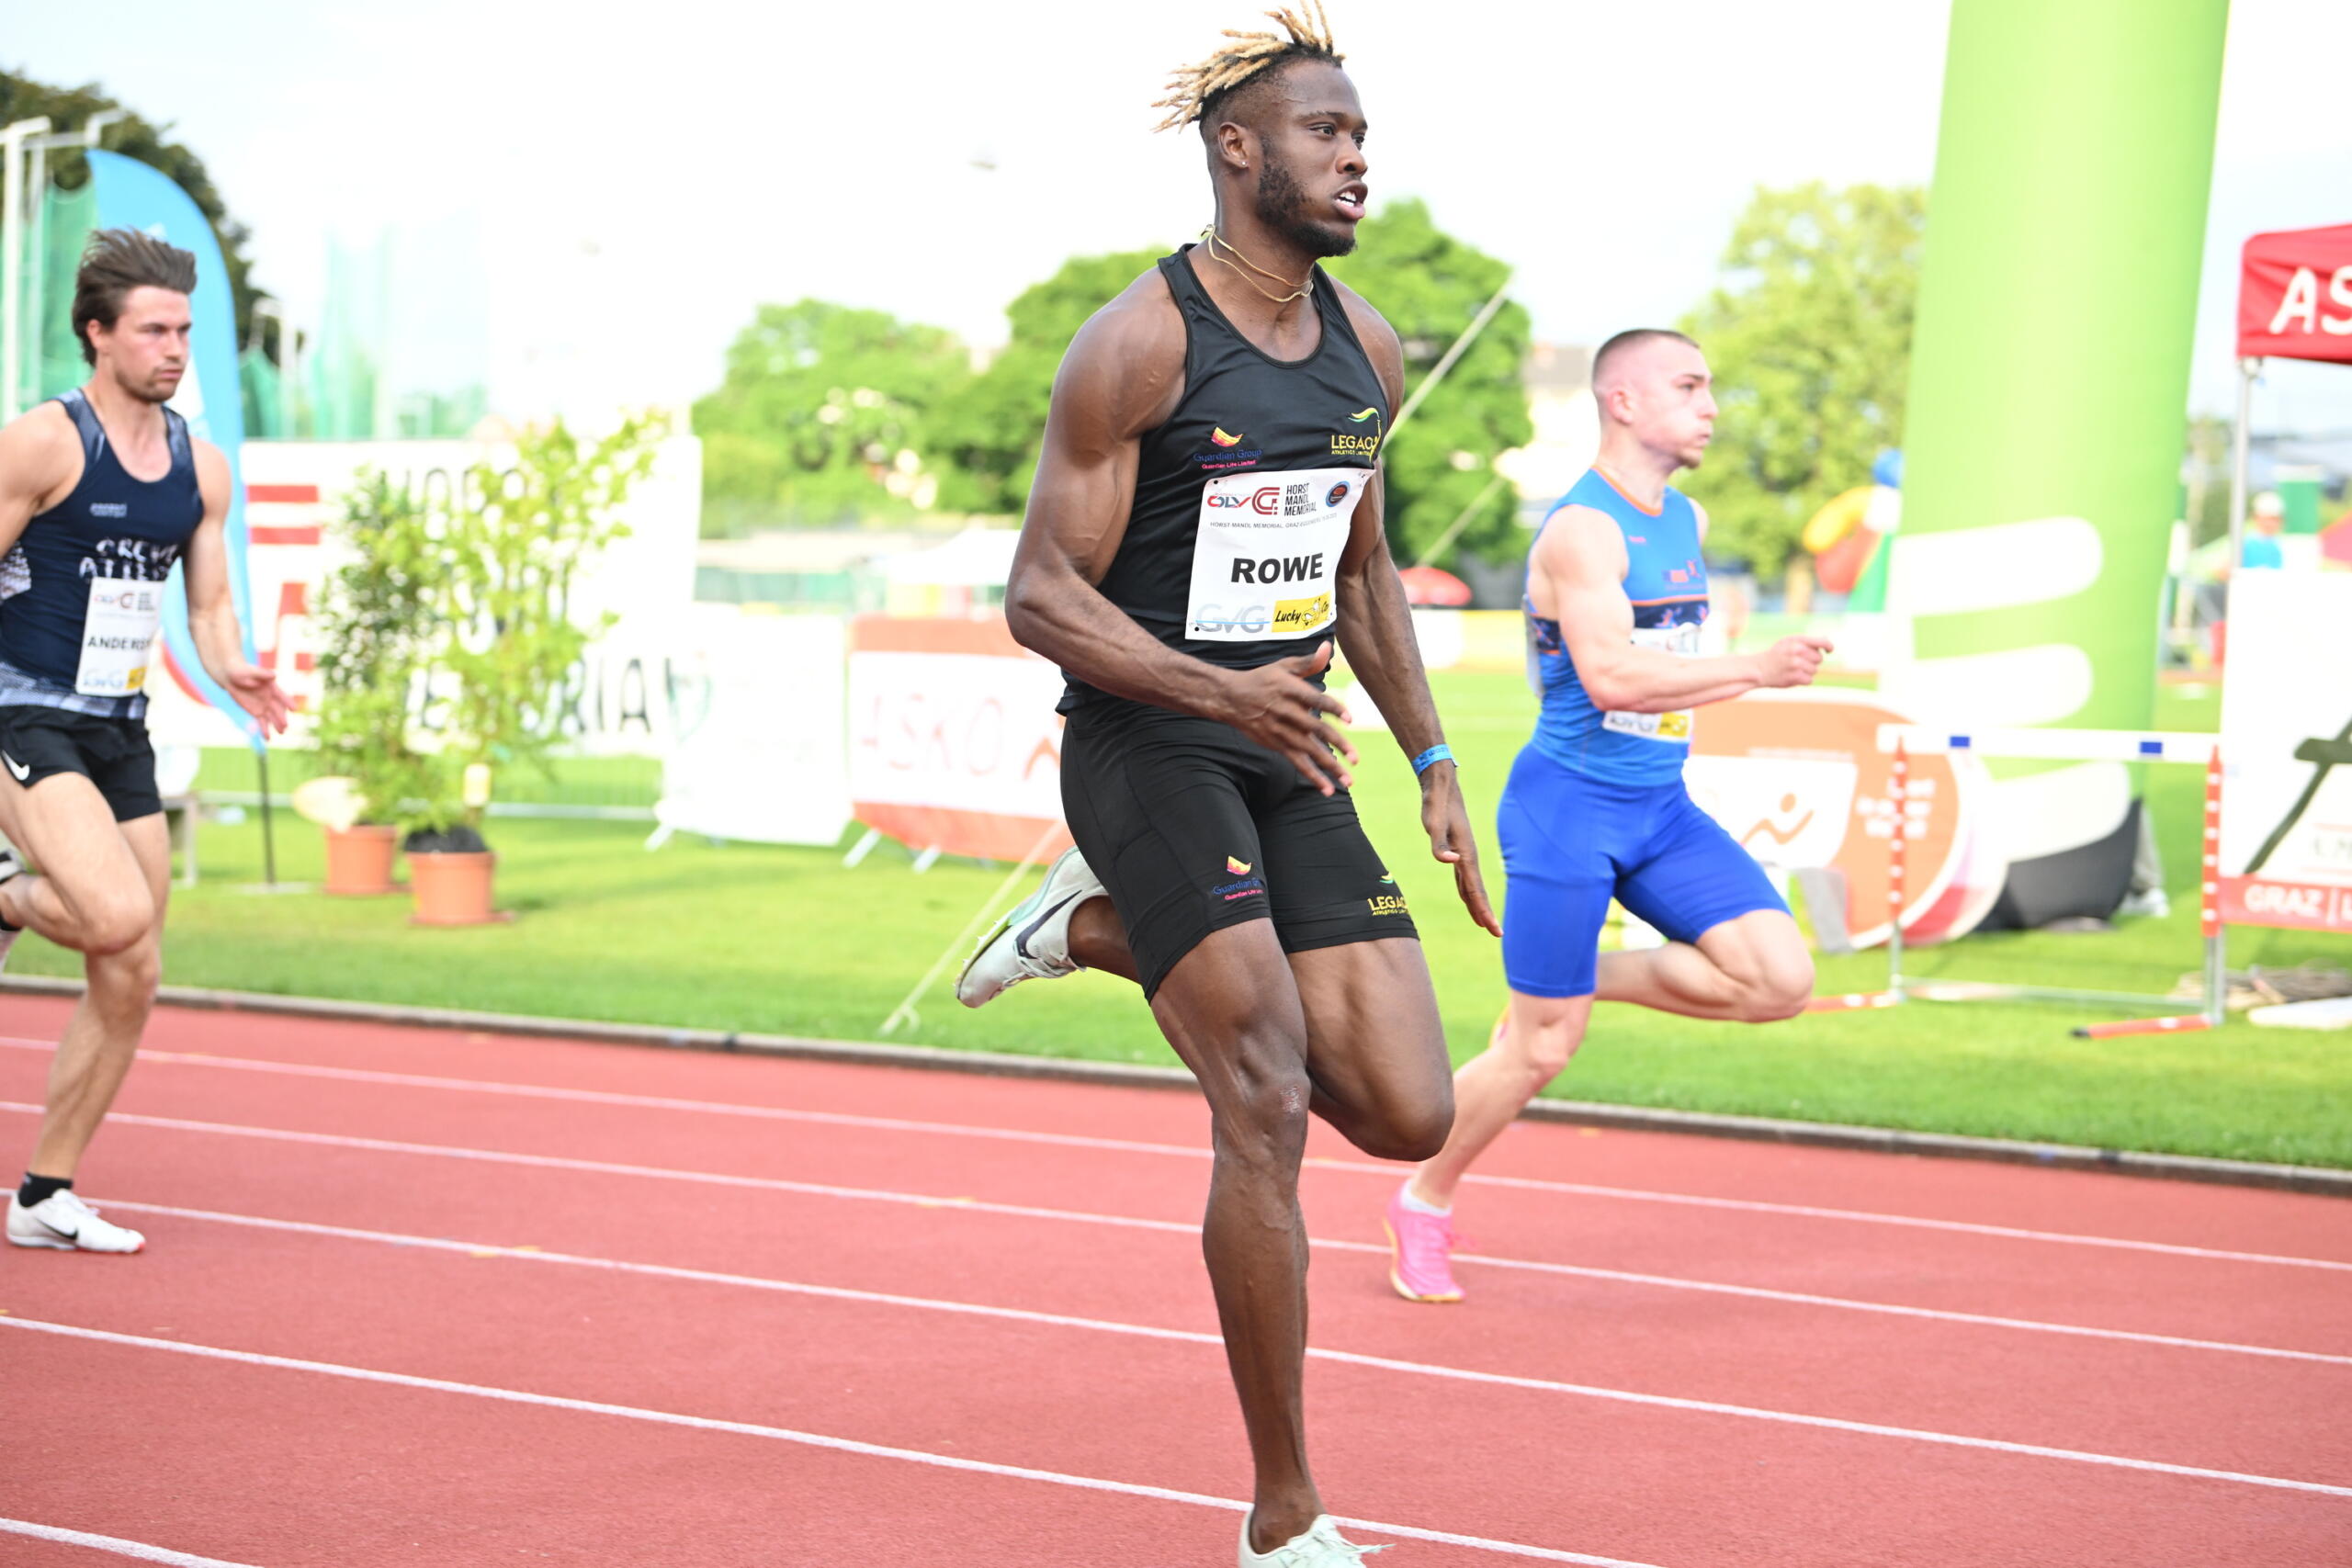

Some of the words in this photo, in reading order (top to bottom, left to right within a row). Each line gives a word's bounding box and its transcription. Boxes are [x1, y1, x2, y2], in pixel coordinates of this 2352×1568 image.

[1194, 451, 1235, 462] Guardian
[1237, 448, 1262, 459] Group
[1286, 482, 1310, 495] HORST
[1284, 493, 1309, 506] MANDL
[1283, 502, 1317, 517] MEMORIAL
[1230, 552, 1323, 584] ROWE
[1274, 609, 1302, 625] Lucky
[1213, 879, 1251, 895] Guardian
